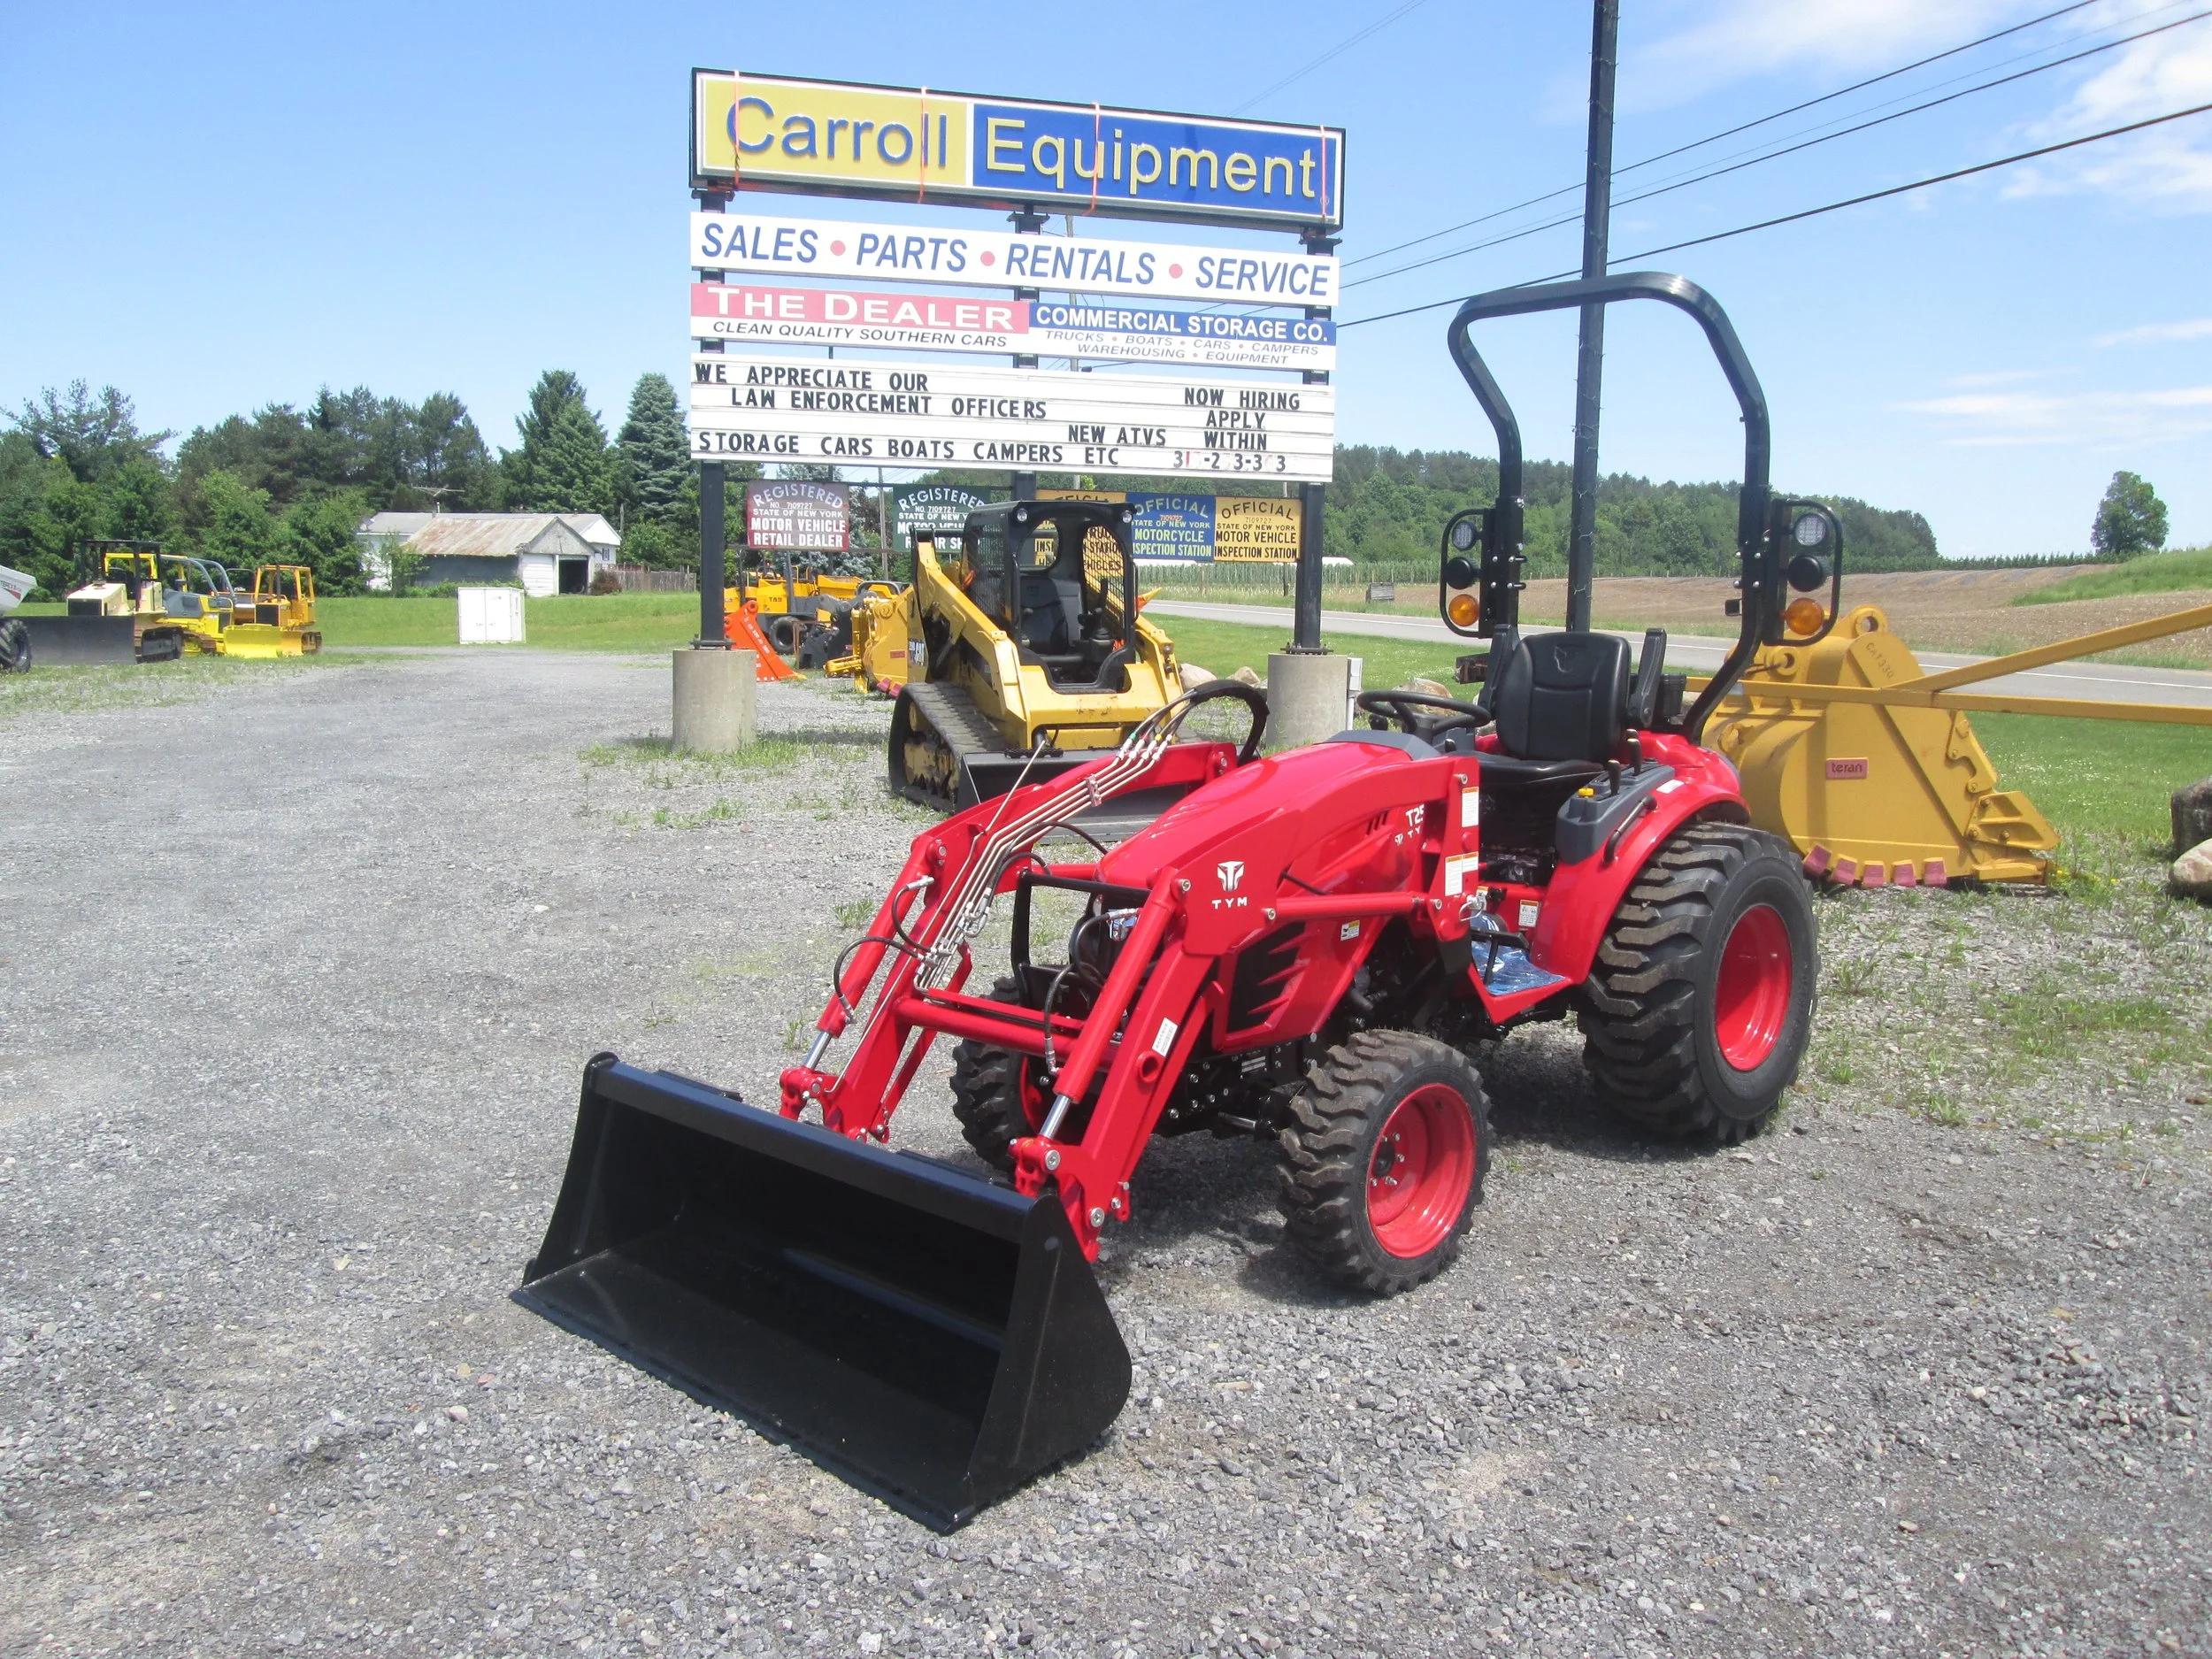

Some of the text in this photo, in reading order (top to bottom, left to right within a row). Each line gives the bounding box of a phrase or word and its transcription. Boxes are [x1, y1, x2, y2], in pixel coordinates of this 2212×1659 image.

[726, 96, 947, 167] Carroll
[987, 116, 1316, 198] Equipment
[701, 222, 1330, 296] SALES PARTS RENTALS SERVICE
[708, 287, 1013, 331] THE DEALER
[713, 321, 1007, 347] CLEAN QUALITY SOUTHERN CARS
[1036, 306, 1328, 342] COMMERCIAL STORAGE CO.
[1045, 330, 1318, 355] TRUCKS BOATS CARS CAMPERS
[1078, 344, 1288, 364] WAREHOUSING EQUIPMENT
[695, 364, 928, 392] WE APPRECIATE OUR
[731, 388, 1046, 419] LAW ENFORCEMENT OFFICERS
[1184, 388, 1300, 411] NOW HIRING
[1206, 410, 1265, 429] APPLY
[1068, 425, 1166, 446] NEW ATVS
[1204, 431, 1267, 450] WITHIN
[699, 431, 1119, 465] STORAGE CARS BOATS CAMPERS ETC
[752, 483, 843, 509] REGISTERED
[1134, 497, 1209, 518] OFFICIAL
[1221, 501, 1294, 521] OFFICIAL
[751, 518, 846, 533] MOTOR VEHICLE
[1134, 528, 1204, 542] MOTORCYCLE
[754, 532, 843, 547] RETAIL DEALER
[1216, 531, 1296, 544] MOTOR VEHICLE
[1133, 542, 1211, 557] SPECTION STATION
[1214, 546, 1297, 559] INSPECTION STATION
[1832, 762, 1863, 773] teran
[1407, 826, 1420, 838] TY
[1211, 896, 1248, 910] TYM
